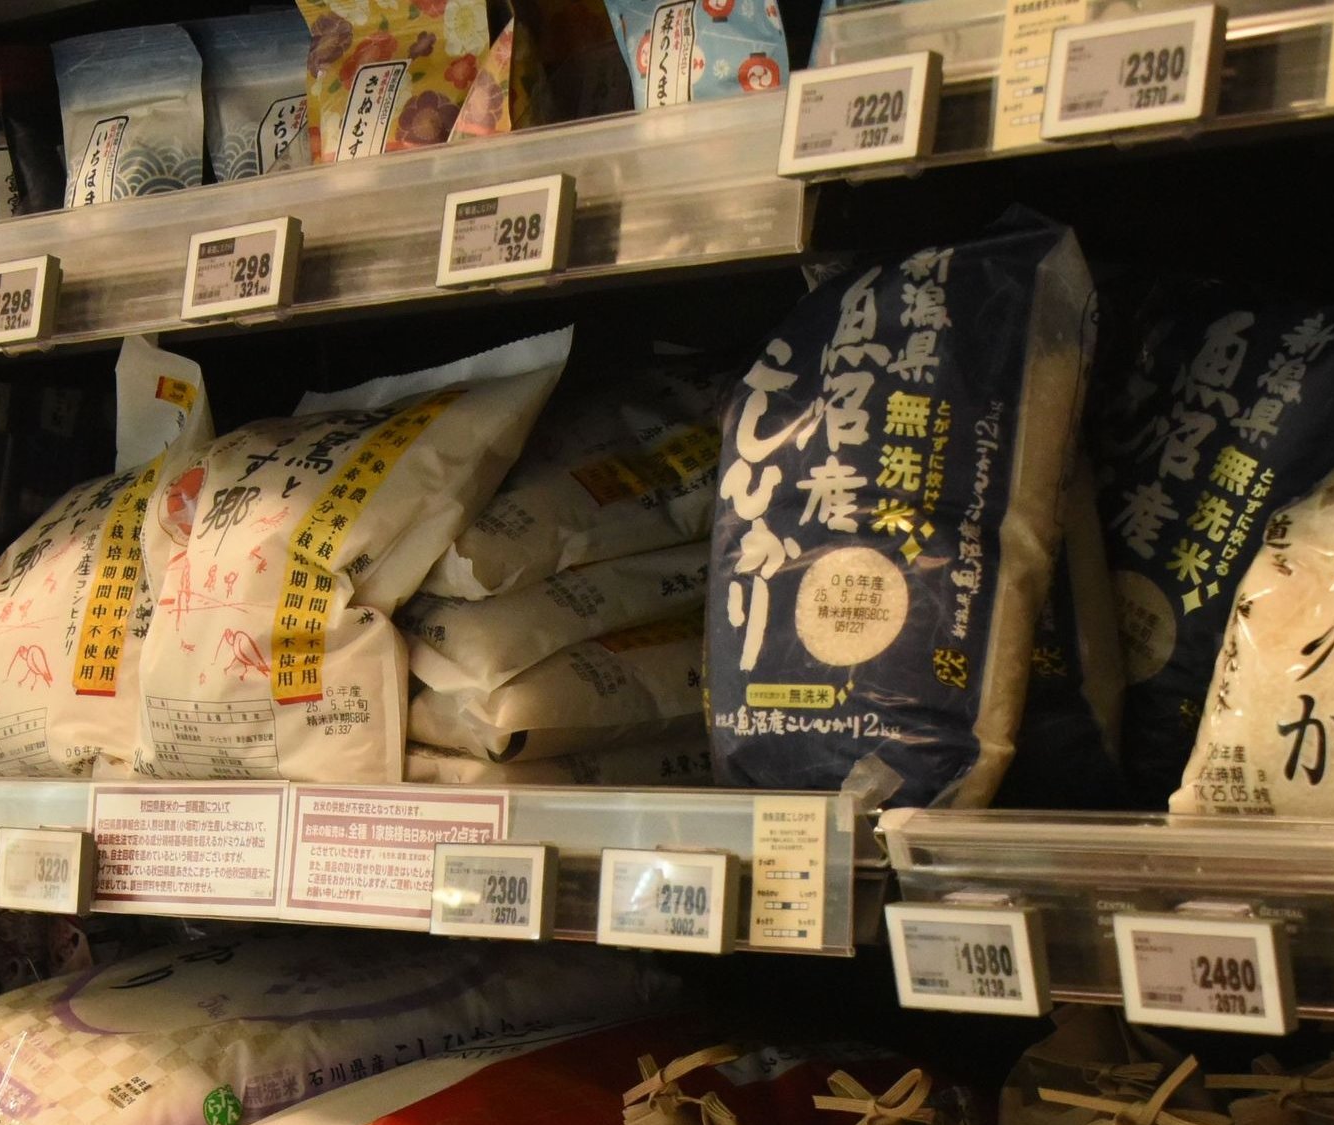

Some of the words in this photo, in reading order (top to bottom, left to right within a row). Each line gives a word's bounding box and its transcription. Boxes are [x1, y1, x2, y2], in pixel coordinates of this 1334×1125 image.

[1124, 47, 1186, 88] 2380
[851, 91, 904, 128] 2220
[498, 215, 542, 246] 298
[233, 252, 271, 282] 298
[0, 289, 32, 316] 298
[885, 246, 955, 385] 新潟県
[797, 265, 892, 536] 魚沼産
[871, 391, 932, 536] 無洗米
[719, 336, 801, 673] こしひかり
[1168, 443, 1261, 587] 無洗米
[831, 575, 885, 591] 06年産
[854, 592, 882, 607] 中旬
[788, 687, 830, 705] 無洗米
[862, 712, 904, 741] 2kg
[33, 855, 68, 882] 3220
[487, 876, 529, 905] 2380
[660, 885, 708, 916] 2780
[961, 942, 1014, 977] 1980
[1195, 956, 1256, 992] 2480
